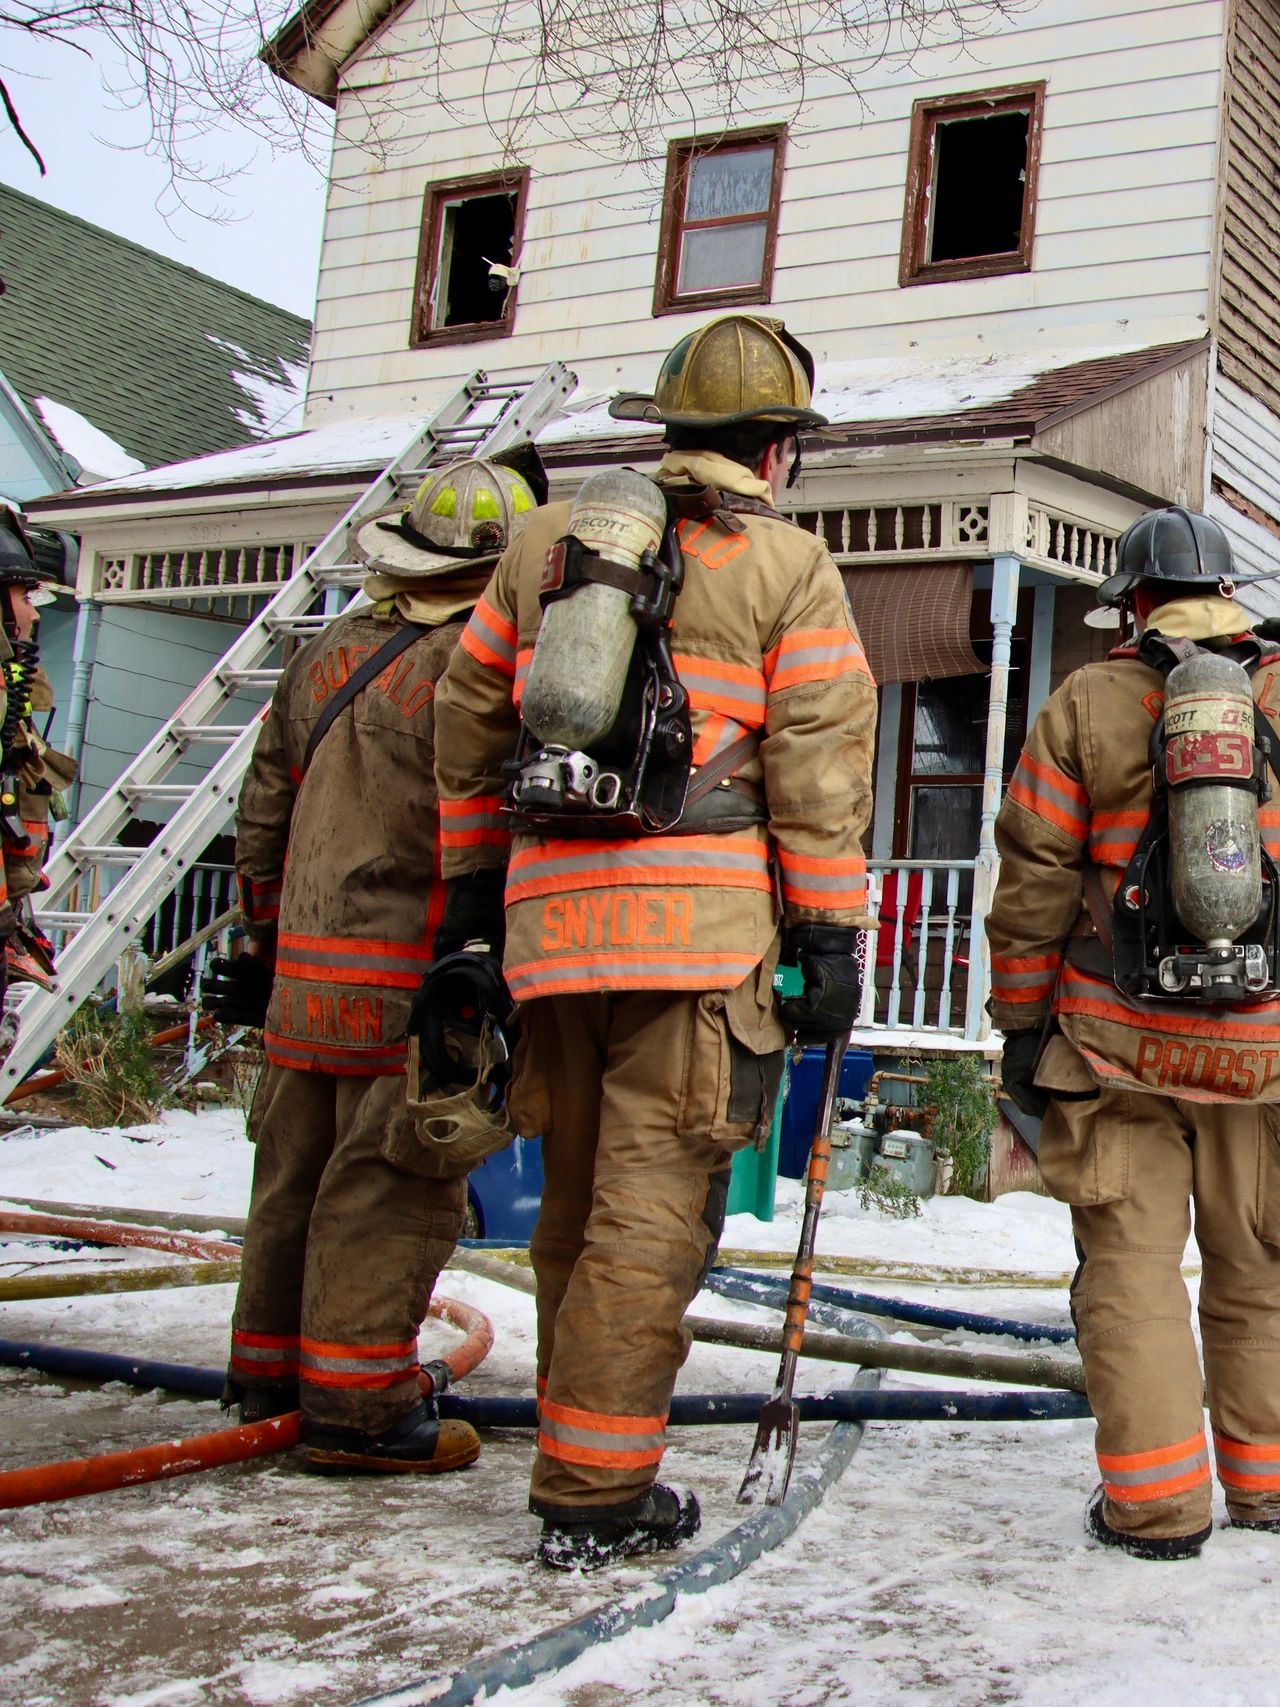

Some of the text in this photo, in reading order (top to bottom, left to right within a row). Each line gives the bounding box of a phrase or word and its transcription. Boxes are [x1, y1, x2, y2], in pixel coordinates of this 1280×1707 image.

[579, 517, 630, 533] SCOTT
[309, 646, 436, 718] BUFALO
[1174, 736, 1243, 775] L-5
[541, 892, 693, 951] SNYDER
[306, 991, 383, 1041] MANN
[1135, 1035, 1279, 1098] PROBST
